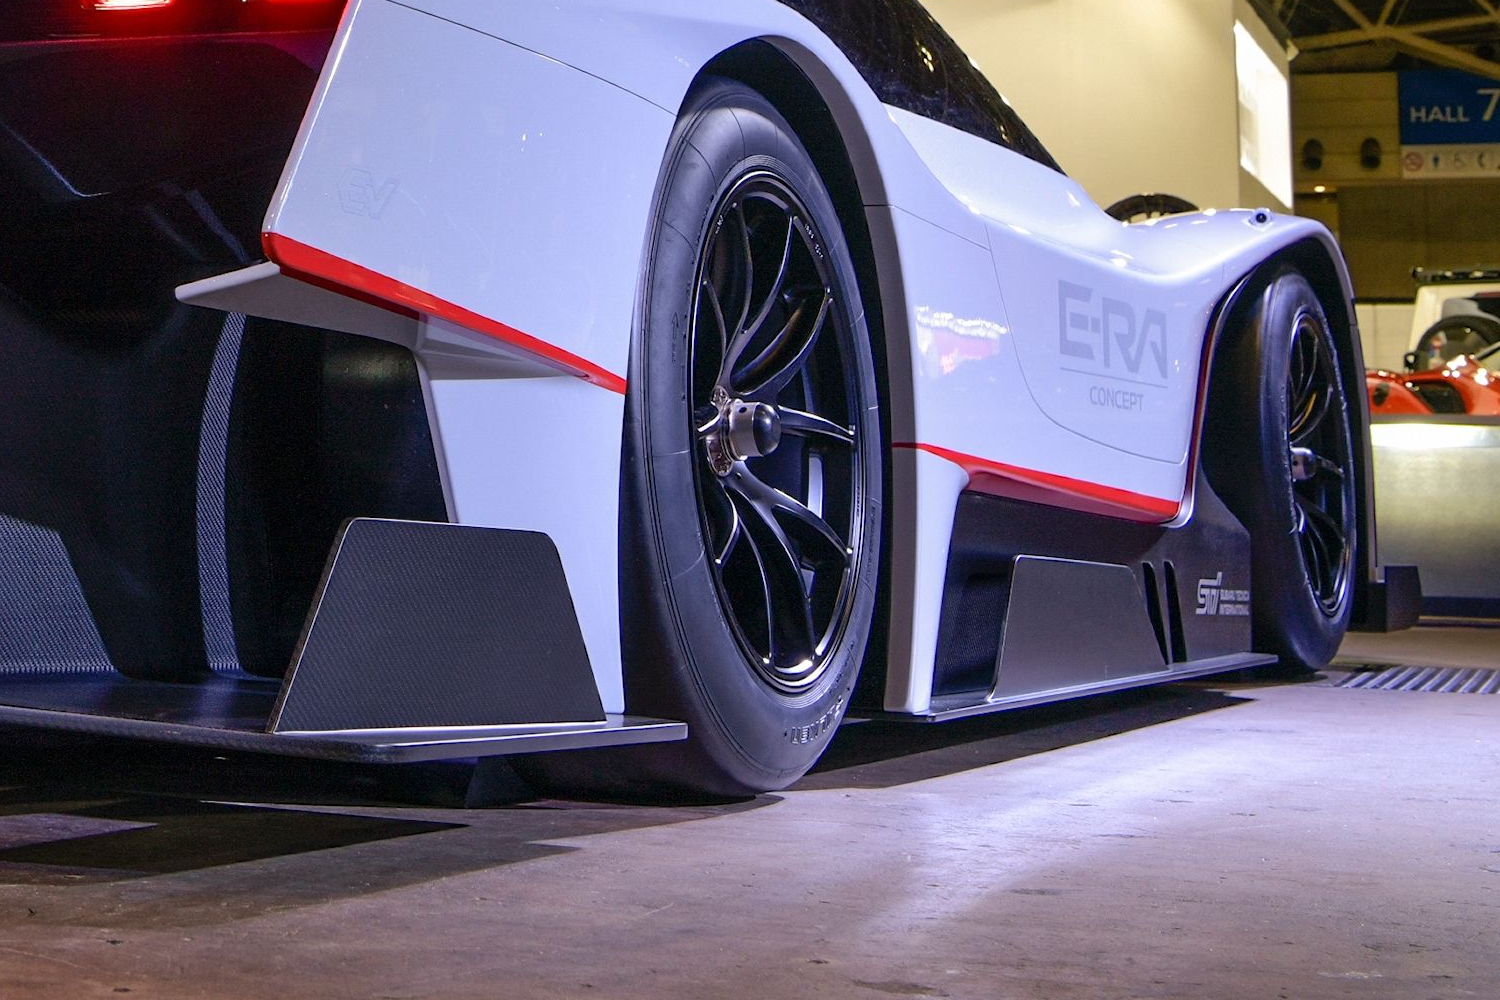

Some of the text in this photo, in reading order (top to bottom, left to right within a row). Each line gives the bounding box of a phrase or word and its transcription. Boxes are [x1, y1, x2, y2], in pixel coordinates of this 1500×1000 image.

[1410, 88, 1500, 122] HALL 7
[1058, 279, 1168, 379] E-RA
[1089, 385, 1144, 412] CONCEPT
